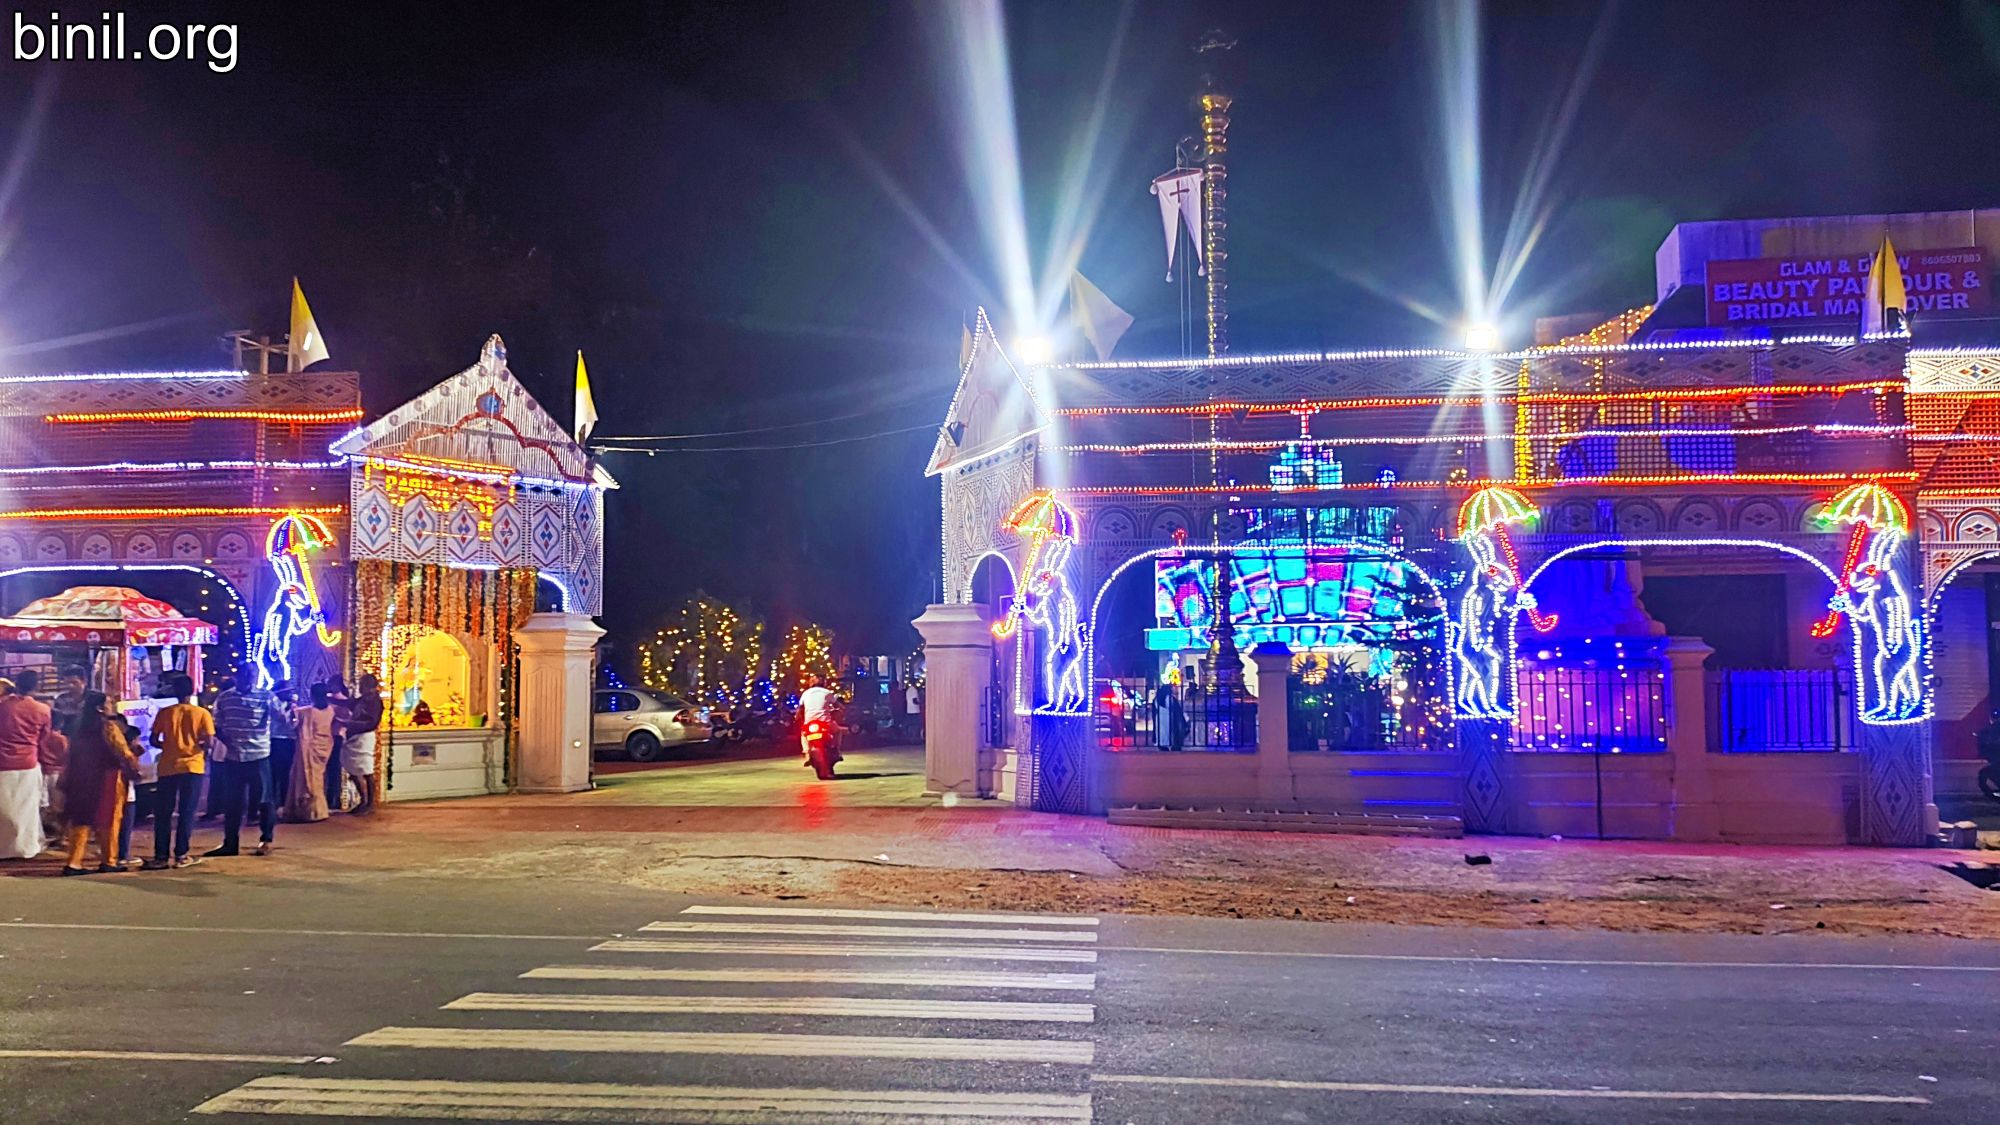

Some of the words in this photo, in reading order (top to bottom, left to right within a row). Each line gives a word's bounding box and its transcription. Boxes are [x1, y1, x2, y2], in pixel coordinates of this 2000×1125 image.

[1780, 260, 1832, 277] GLAM
[1837, 259, 1851, 273] &
[1857, 255, 1911, 272] GW
[1713, 279, 1820, 302] BEAUTY
[1828, 271, 1953, 296] PAOUR
[1961, 270, 1981, 289] &
[1727, 301, 1817, 321] BRIDAL
[1824, 292, 1970, 316] MAOVER
